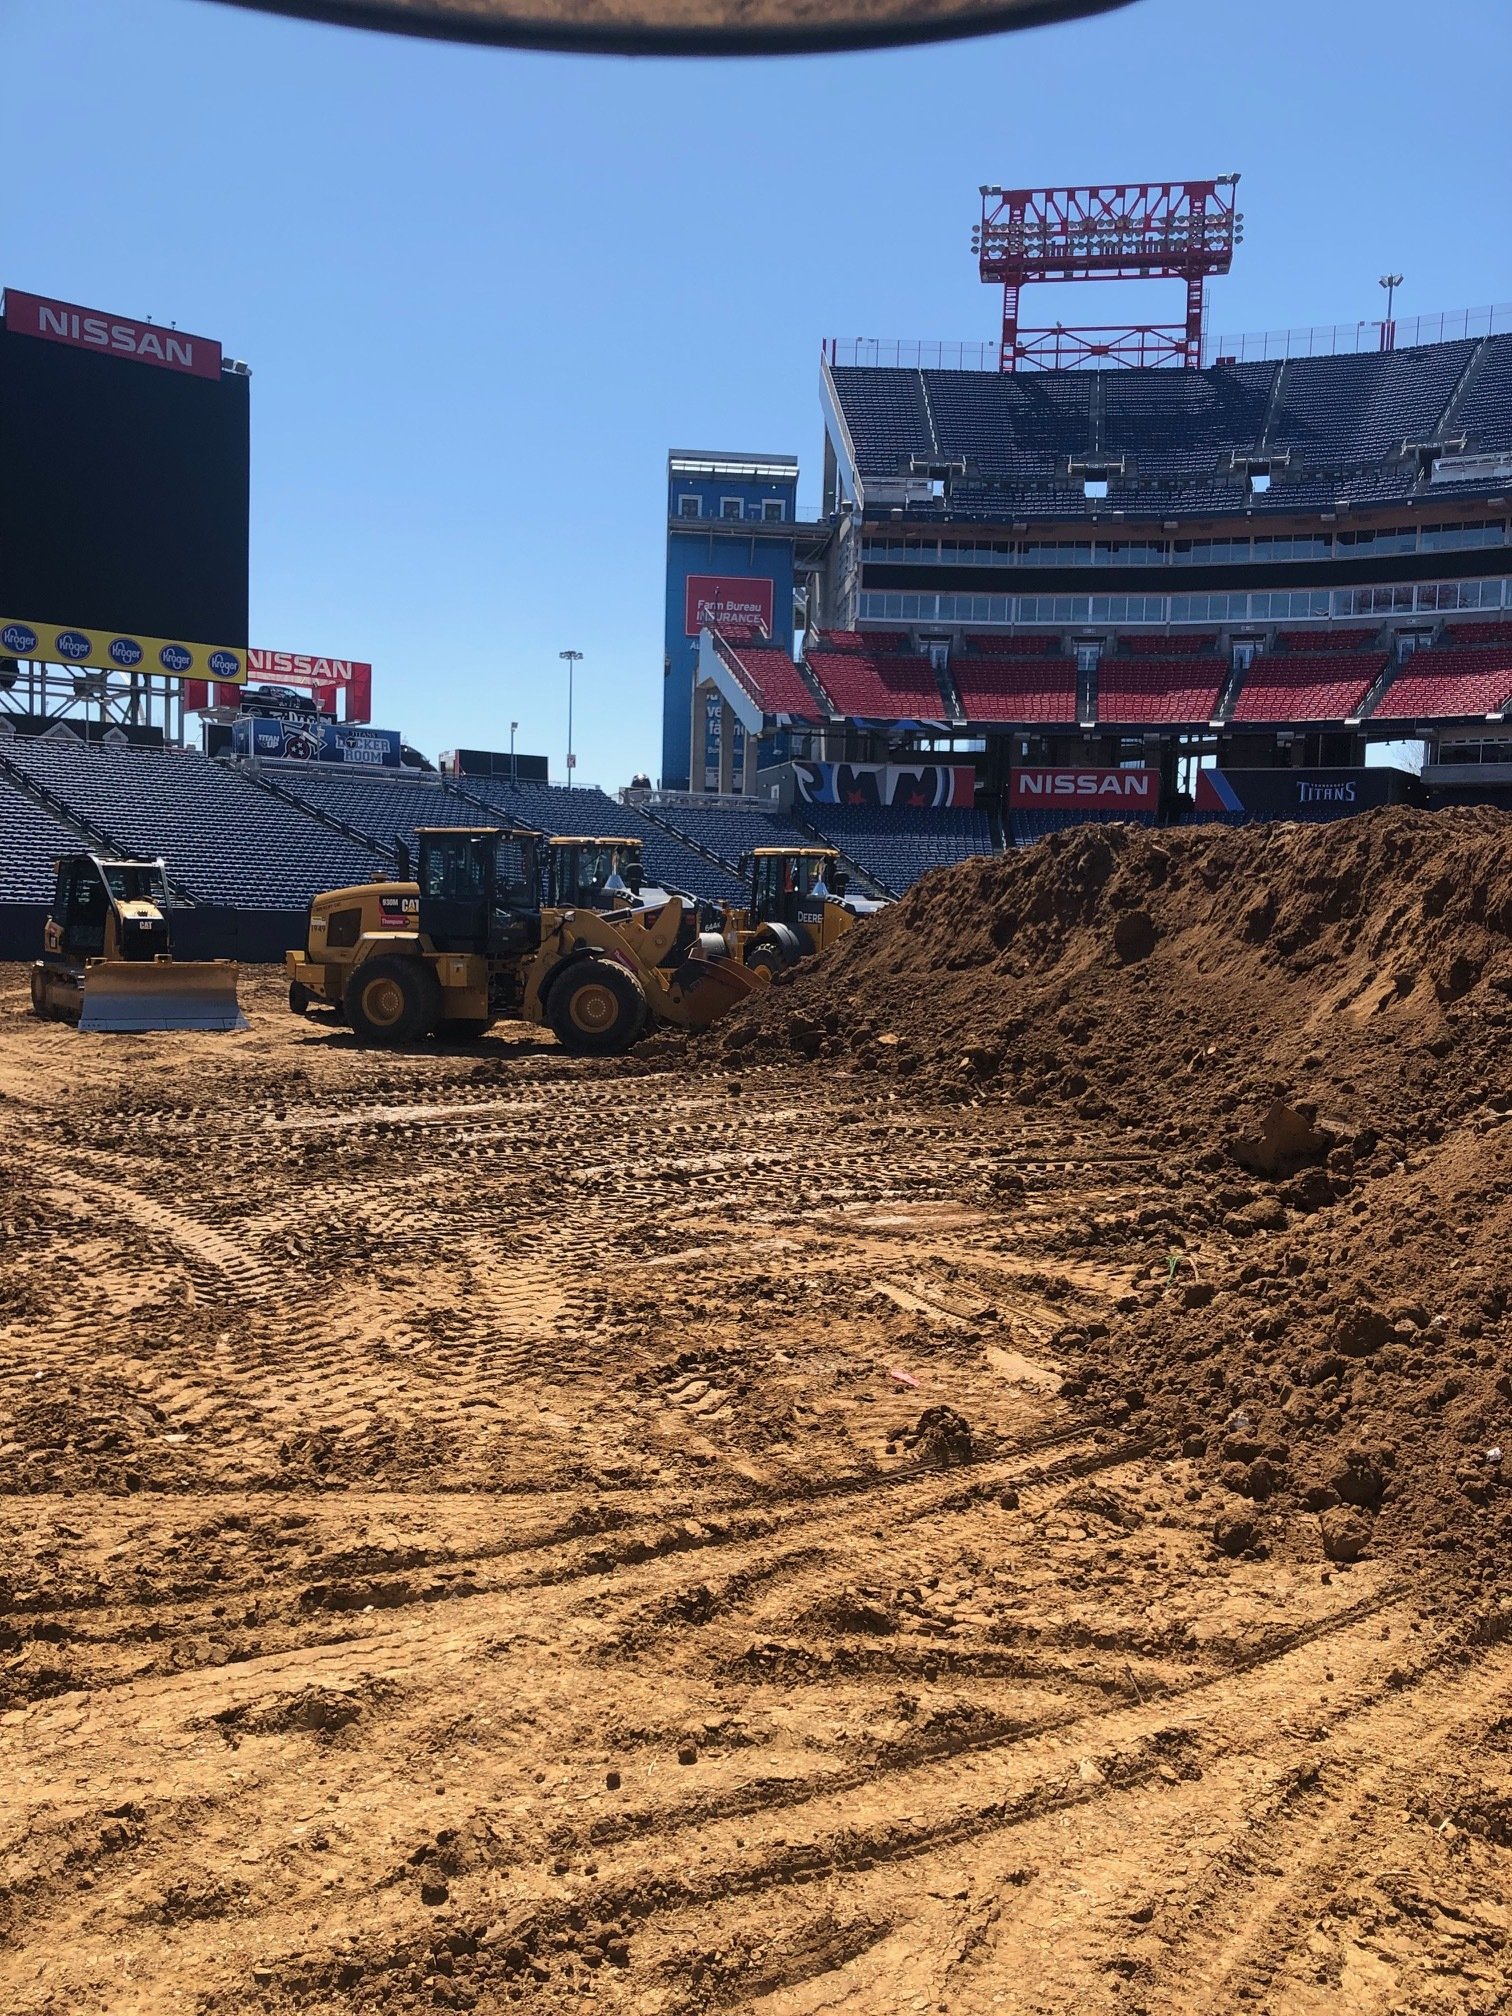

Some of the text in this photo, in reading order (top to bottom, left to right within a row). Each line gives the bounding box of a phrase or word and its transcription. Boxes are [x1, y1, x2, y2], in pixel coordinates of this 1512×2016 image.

[39, 306, 192, 366] NISSAN
[698, 600, 761, 612] Farm Bureau
[697, 611, 761, 623] INSURANCE
[4, 628, 36, 650] Kroger
[59, 635, 89, 657] Kroger
[112, 642, 141, 663] Kroger
[162, 649, 191, 669] Kroger
[211, 655, 239, 675] Kroger
[248, 650, 352, 679] NISSAN
[344, 750, 383, 763] ROOM
[1020, 774, 1148, 795] NISSAN
[1297, 781, 1356, 802] TITANS
[402, 898, 419, 912] CAT
[139, 921, 153, 930] CAT
[797, 911, 823, 923] DEERE
